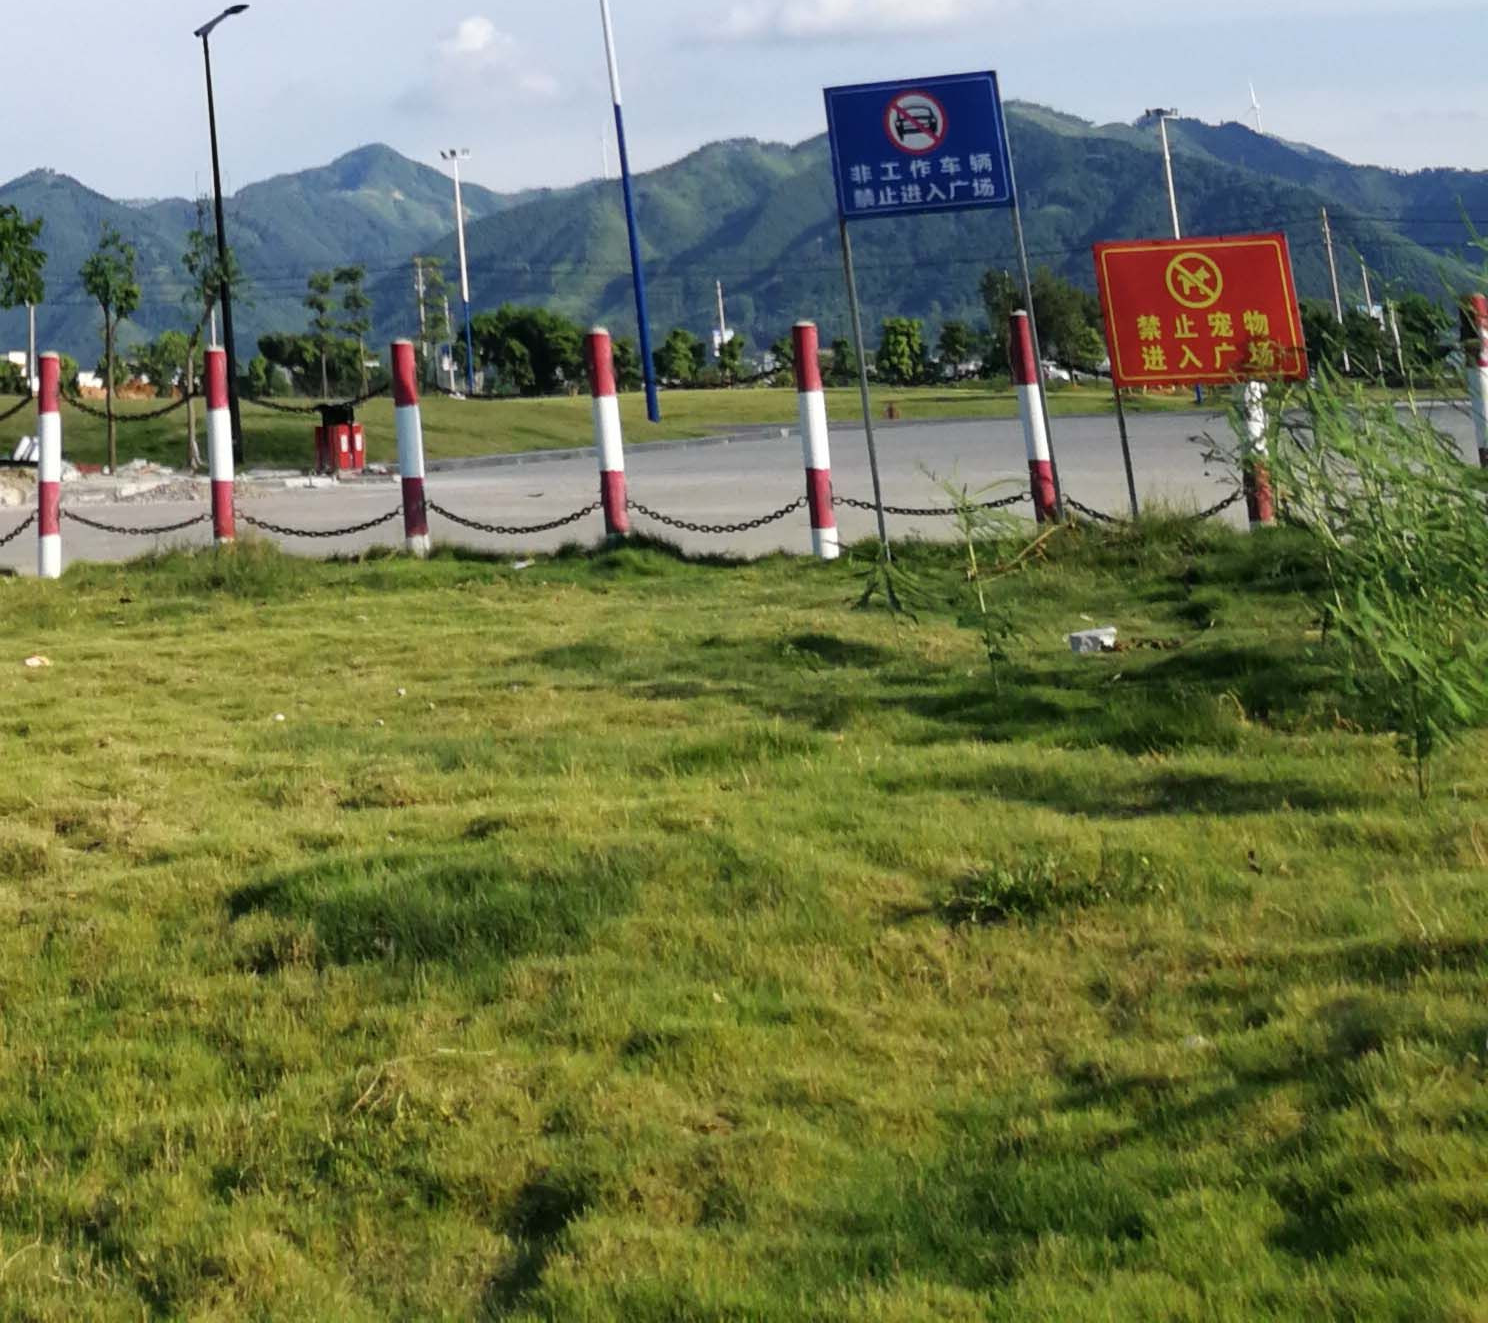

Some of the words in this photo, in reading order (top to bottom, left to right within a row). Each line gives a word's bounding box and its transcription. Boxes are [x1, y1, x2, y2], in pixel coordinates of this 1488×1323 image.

[850, 153, 992, 184] 非工作车辆
[854, 178, 995, 208] 禁止进入广场
[1137, 310, 1269, 340] 禁止宠物
[1142, 341, 1275, 371] 进入广场
